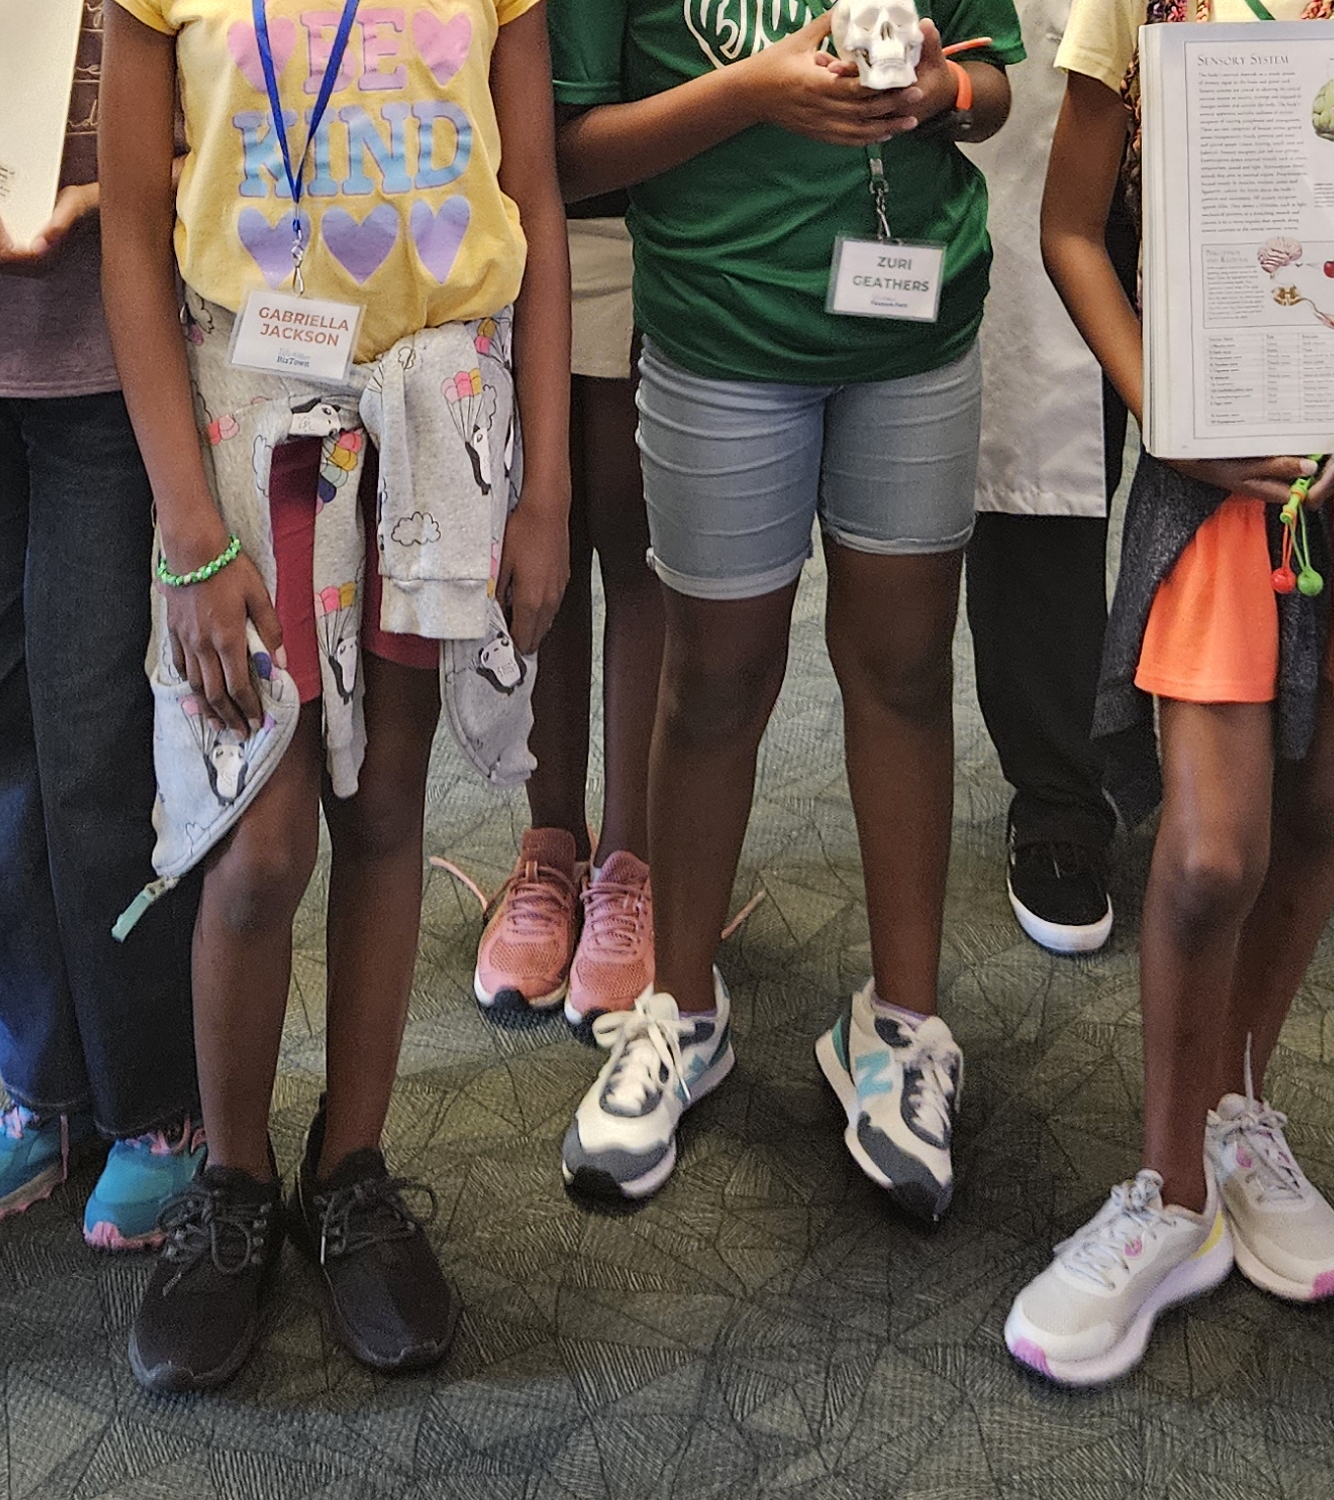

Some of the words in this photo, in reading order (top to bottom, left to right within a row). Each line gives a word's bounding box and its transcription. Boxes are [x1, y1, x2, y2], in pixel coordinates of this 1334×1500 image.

[301, 7, 409, 95] BE
[231, 99, 474, 199] KIND
[877, 256, 913, 271] ZURI
[852, 275, 930, 293] GEATHERS
[258, 306, 349, 332] GABRIELLA
[259, 323, 340, 347] JACKSON
